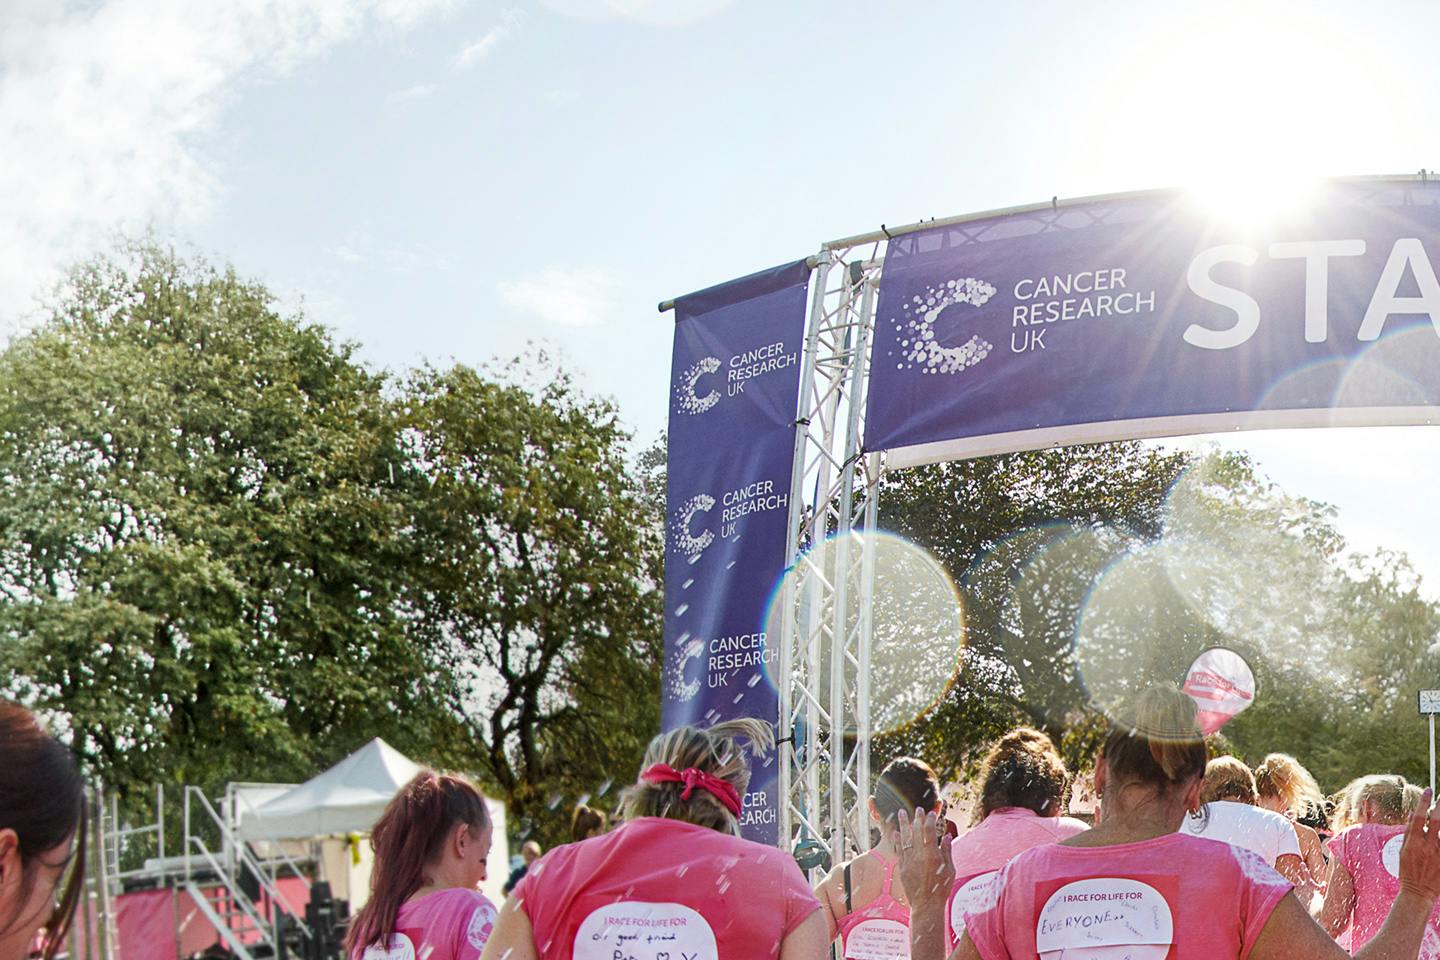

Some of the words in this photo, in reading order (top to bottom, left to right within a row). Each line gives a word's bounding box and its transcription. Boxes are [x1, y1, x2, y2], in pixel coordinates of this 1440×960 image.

[1014, 268, 1126, 300] CANCER
[1013, 291, 1155, 327] RESEARCH
[1011, 329, 1046, 353] UK
[729, 342, 784, 368] CANCER
[728, 353, 797, 382] RESEARCH
[727, 382, 745, 397] UK
[722, 480, 774, 506] CANCER
[722, 494, 787, 523] RESEARCH
[721, 522, 737, 538] UK
[709, 632, 768, 653] CANCER
[708, 648, 779, 671] RESEARCH
[708, 673, 728, 688] UK
[743, 791, 767, 807] CER
[740, 809, 776, 826] EARCH
[1067, 894, 1088, 903] RACE
[1090, 893, 1107, 901] FOR
[1108, 892, 1125, 901] LIFE
[1126, 892, 1143, 900] FOR
[633, 918, 650, 927] FOR
[652, 919, 668, 927] LIFE
[670, 918, 687, 926] FOR
